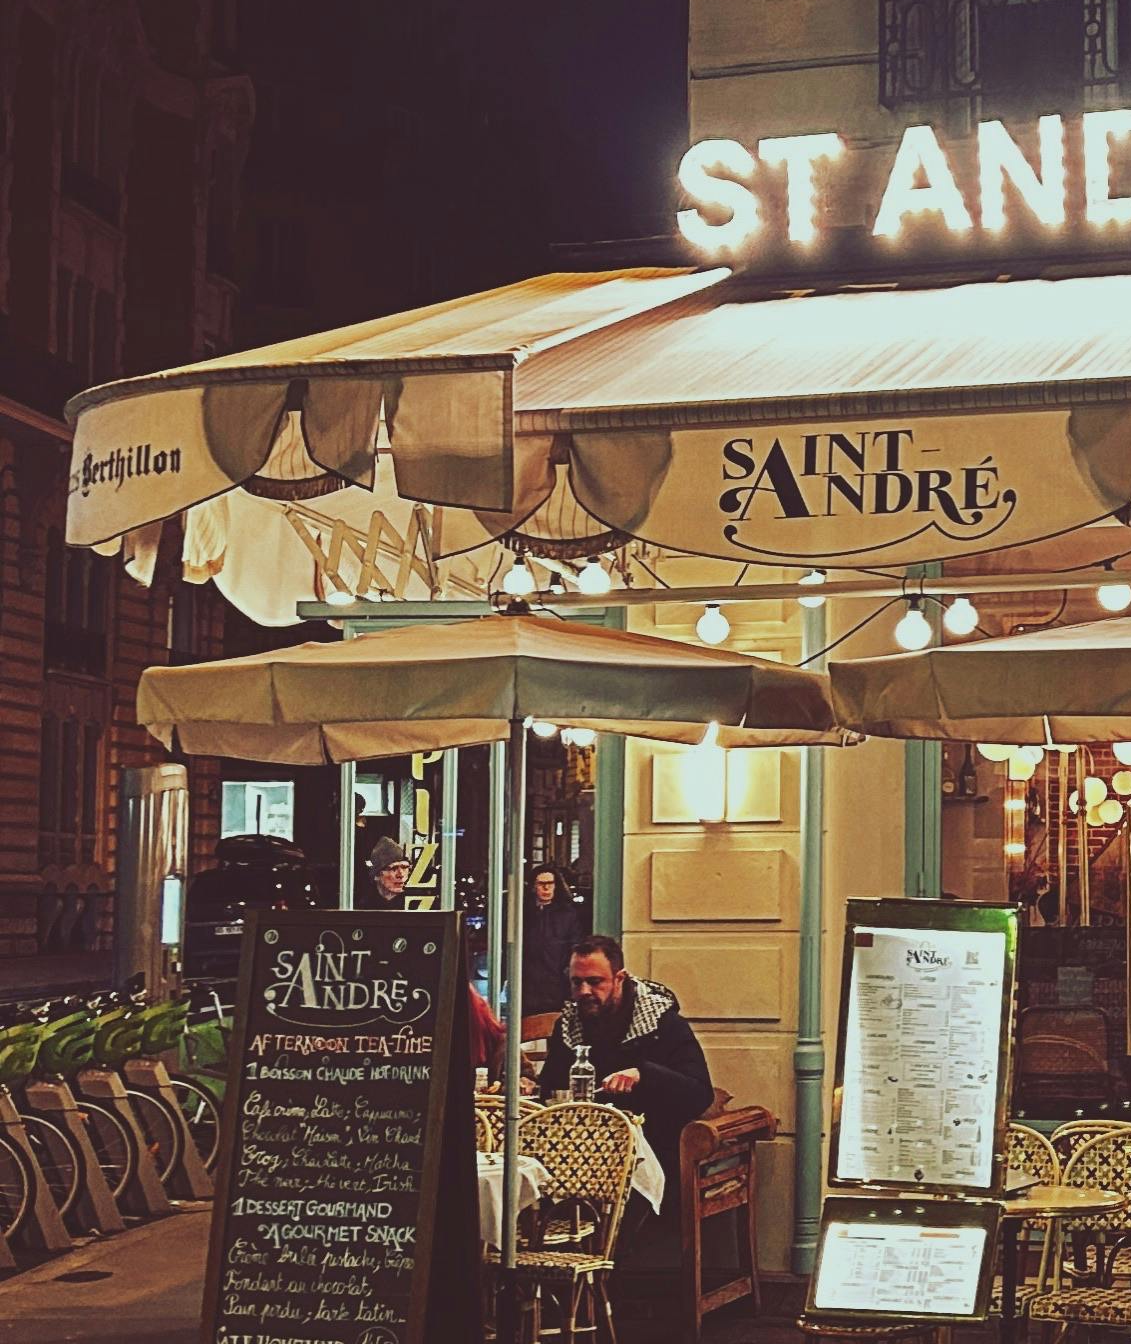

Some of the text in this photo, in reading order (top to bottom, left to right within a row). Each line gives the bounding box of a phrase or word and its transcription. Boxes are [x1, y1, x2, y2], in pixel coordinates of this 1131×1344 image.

[676, 133, 847, 251] ST
[82, 443, 181, 497] Berthillon
[719, 441, 1002, 525] ANDRÉ
[249, 1033, 350, 1056] AFTERNOON
[246, 1061, 258, 1080] 1
[259, 1064, 312, 1081] BOISSON
[316, 1065, 365, 1085] CHAUDE
[231, 1196, 393, 1222] 1 DESSERT GOURMAND
[281, 1224, 363, 1248] GOURMET
[365, 1224, 417, 1252] SNACK
[223, 1268, 283, 1292] Fondant
